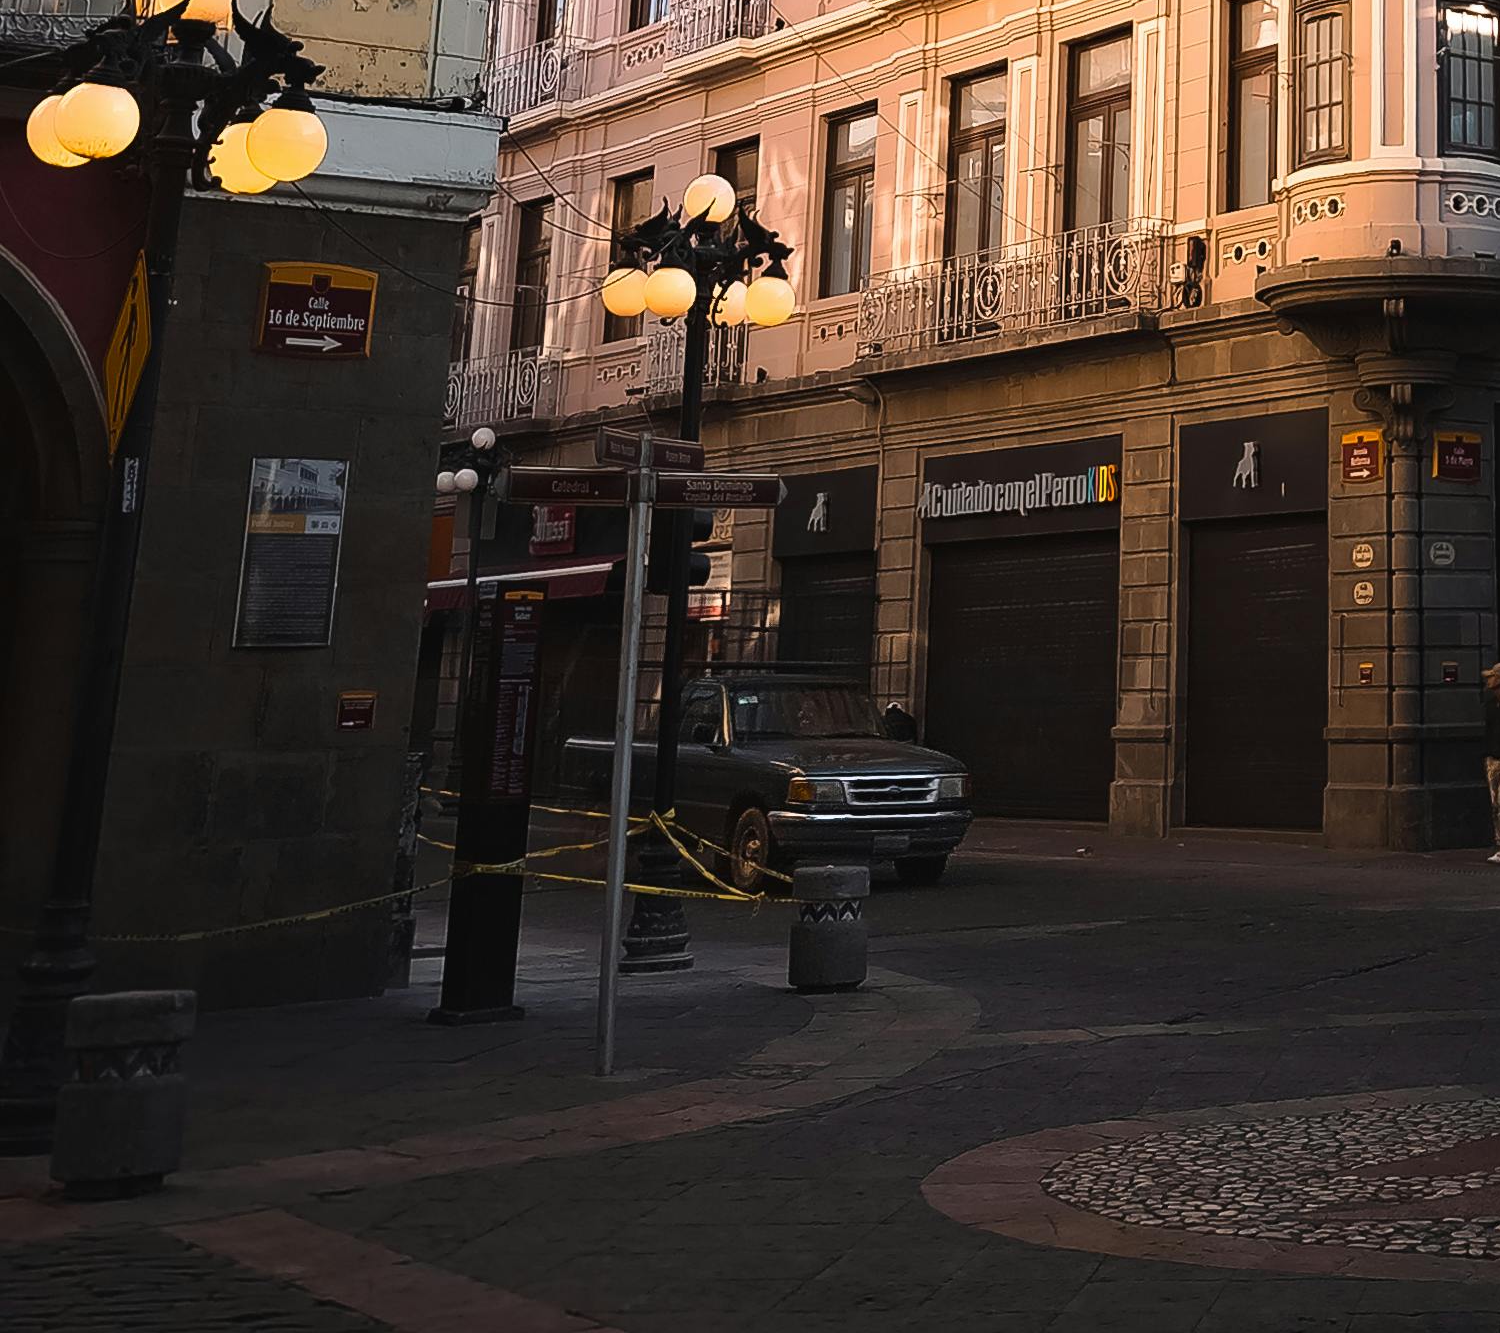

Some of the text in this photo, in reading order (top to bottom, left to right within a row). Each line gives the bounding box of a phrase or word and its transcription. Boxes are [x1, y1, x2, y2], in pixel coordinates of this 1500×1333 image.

[308, 296, 331, 310] Calle
[268, 309, 365, 331] 16 de Septiembre
[551, 480, 590, 494] Catedral
[686, 479, 753, 494] Santo Domingo
[1087, 464, 1118, 504] KIDS
